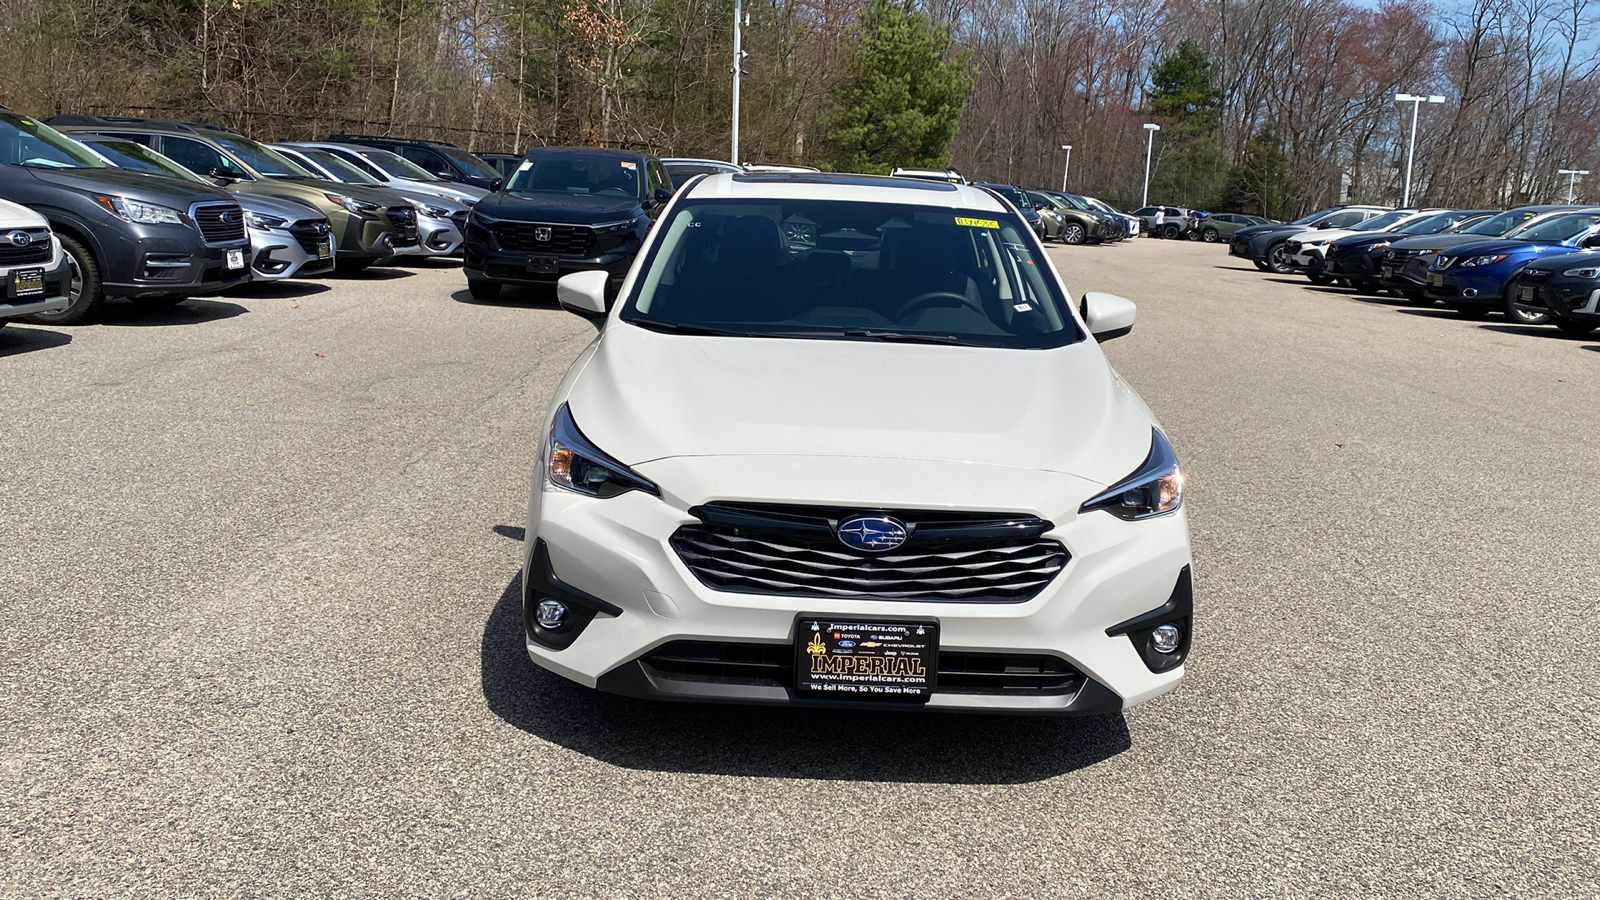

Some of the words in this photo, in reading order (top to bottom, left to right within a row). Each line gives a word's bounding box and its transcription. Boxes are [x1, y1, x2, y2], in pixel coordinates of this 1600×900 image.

[830, 623, 907, 633] Imperialcars.com
[811, 654, 926, 677] IMPERIAL
[839, 685, 858, 693] More,
